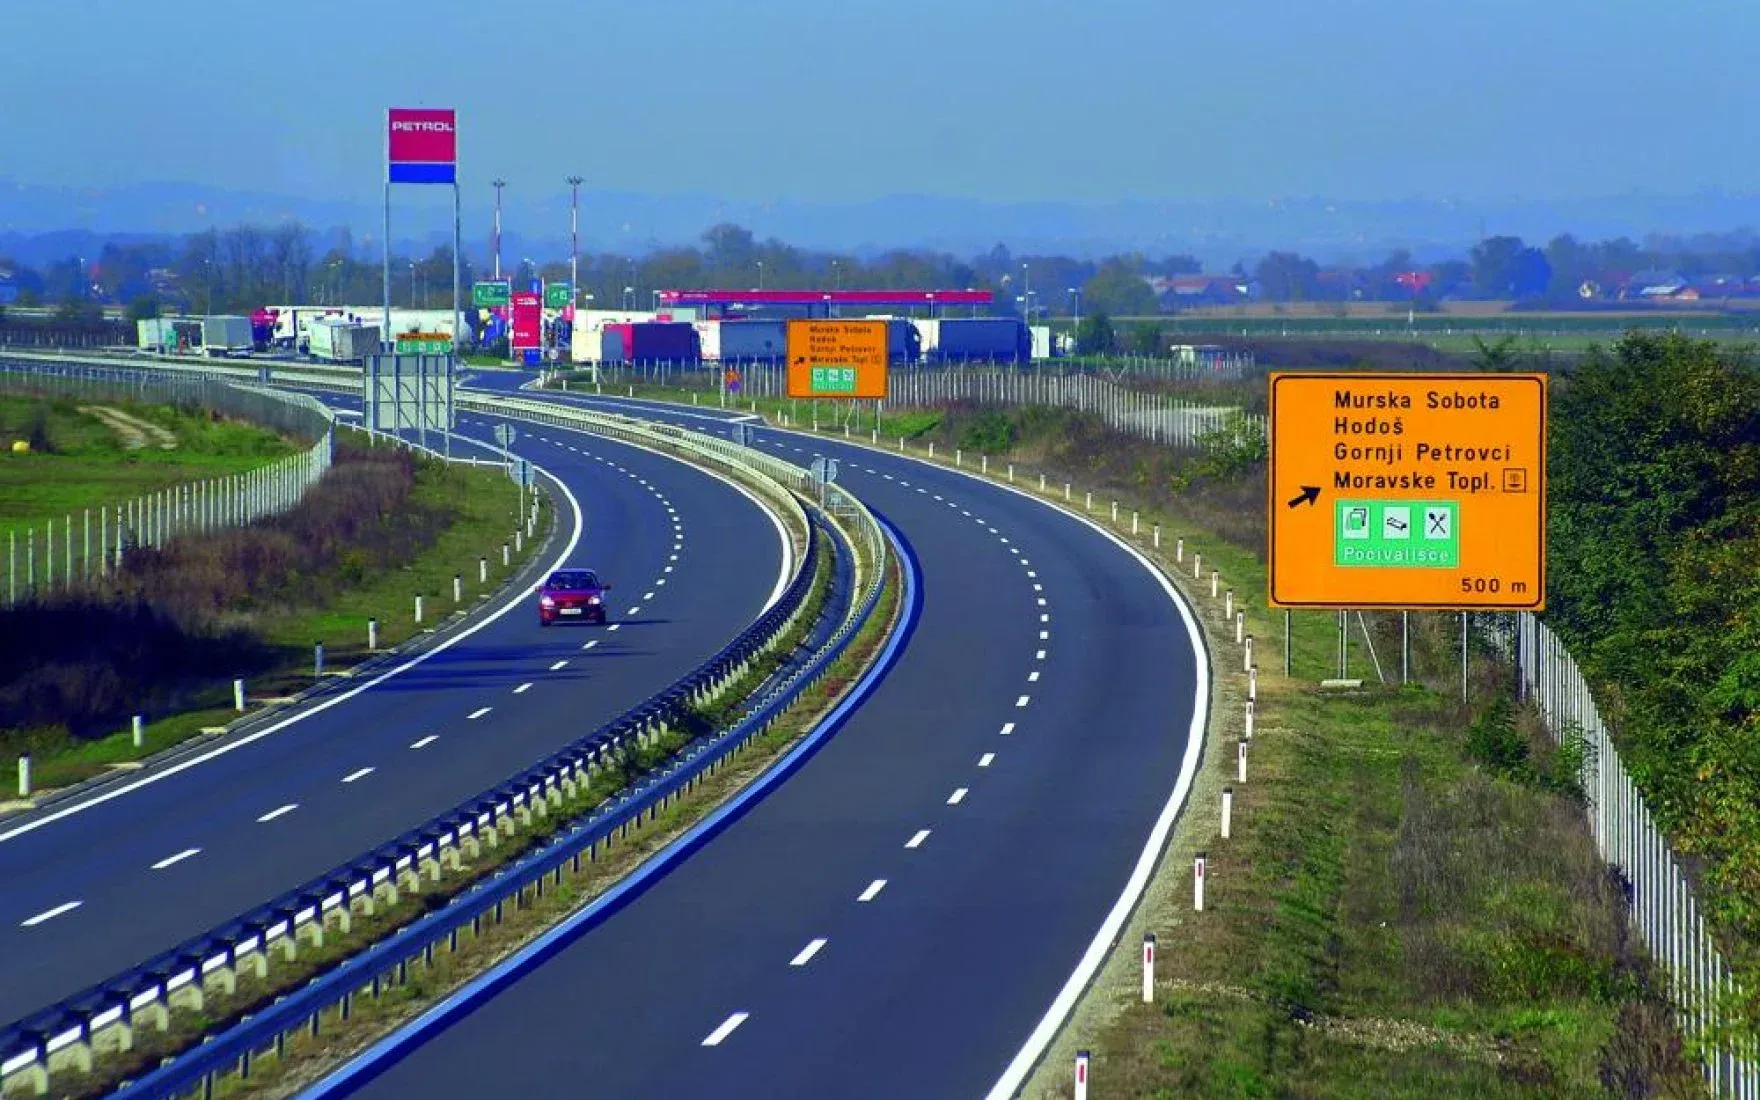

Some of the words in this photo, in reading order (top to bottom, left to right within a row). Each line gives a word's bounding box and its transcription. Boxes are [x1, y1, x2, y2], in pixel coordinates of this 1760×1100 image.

[392, 120, 454, 131] PETROL
[1334, 390, 1410, 409] Murska
[1427, 390, 1500, 409] Sobota
[1334, 416, 1403, 435] Hodoš
[1334, 442, 1402, 465] Gornji
[1416, 442, 1511, 462] Petrovci
[1334, 471, 1435, 490] Moravske
[1448, 471, 1495, 494] Topl.
[1461, 577, 1500, 593] 500
[1511, 581, 1527, 593] m
